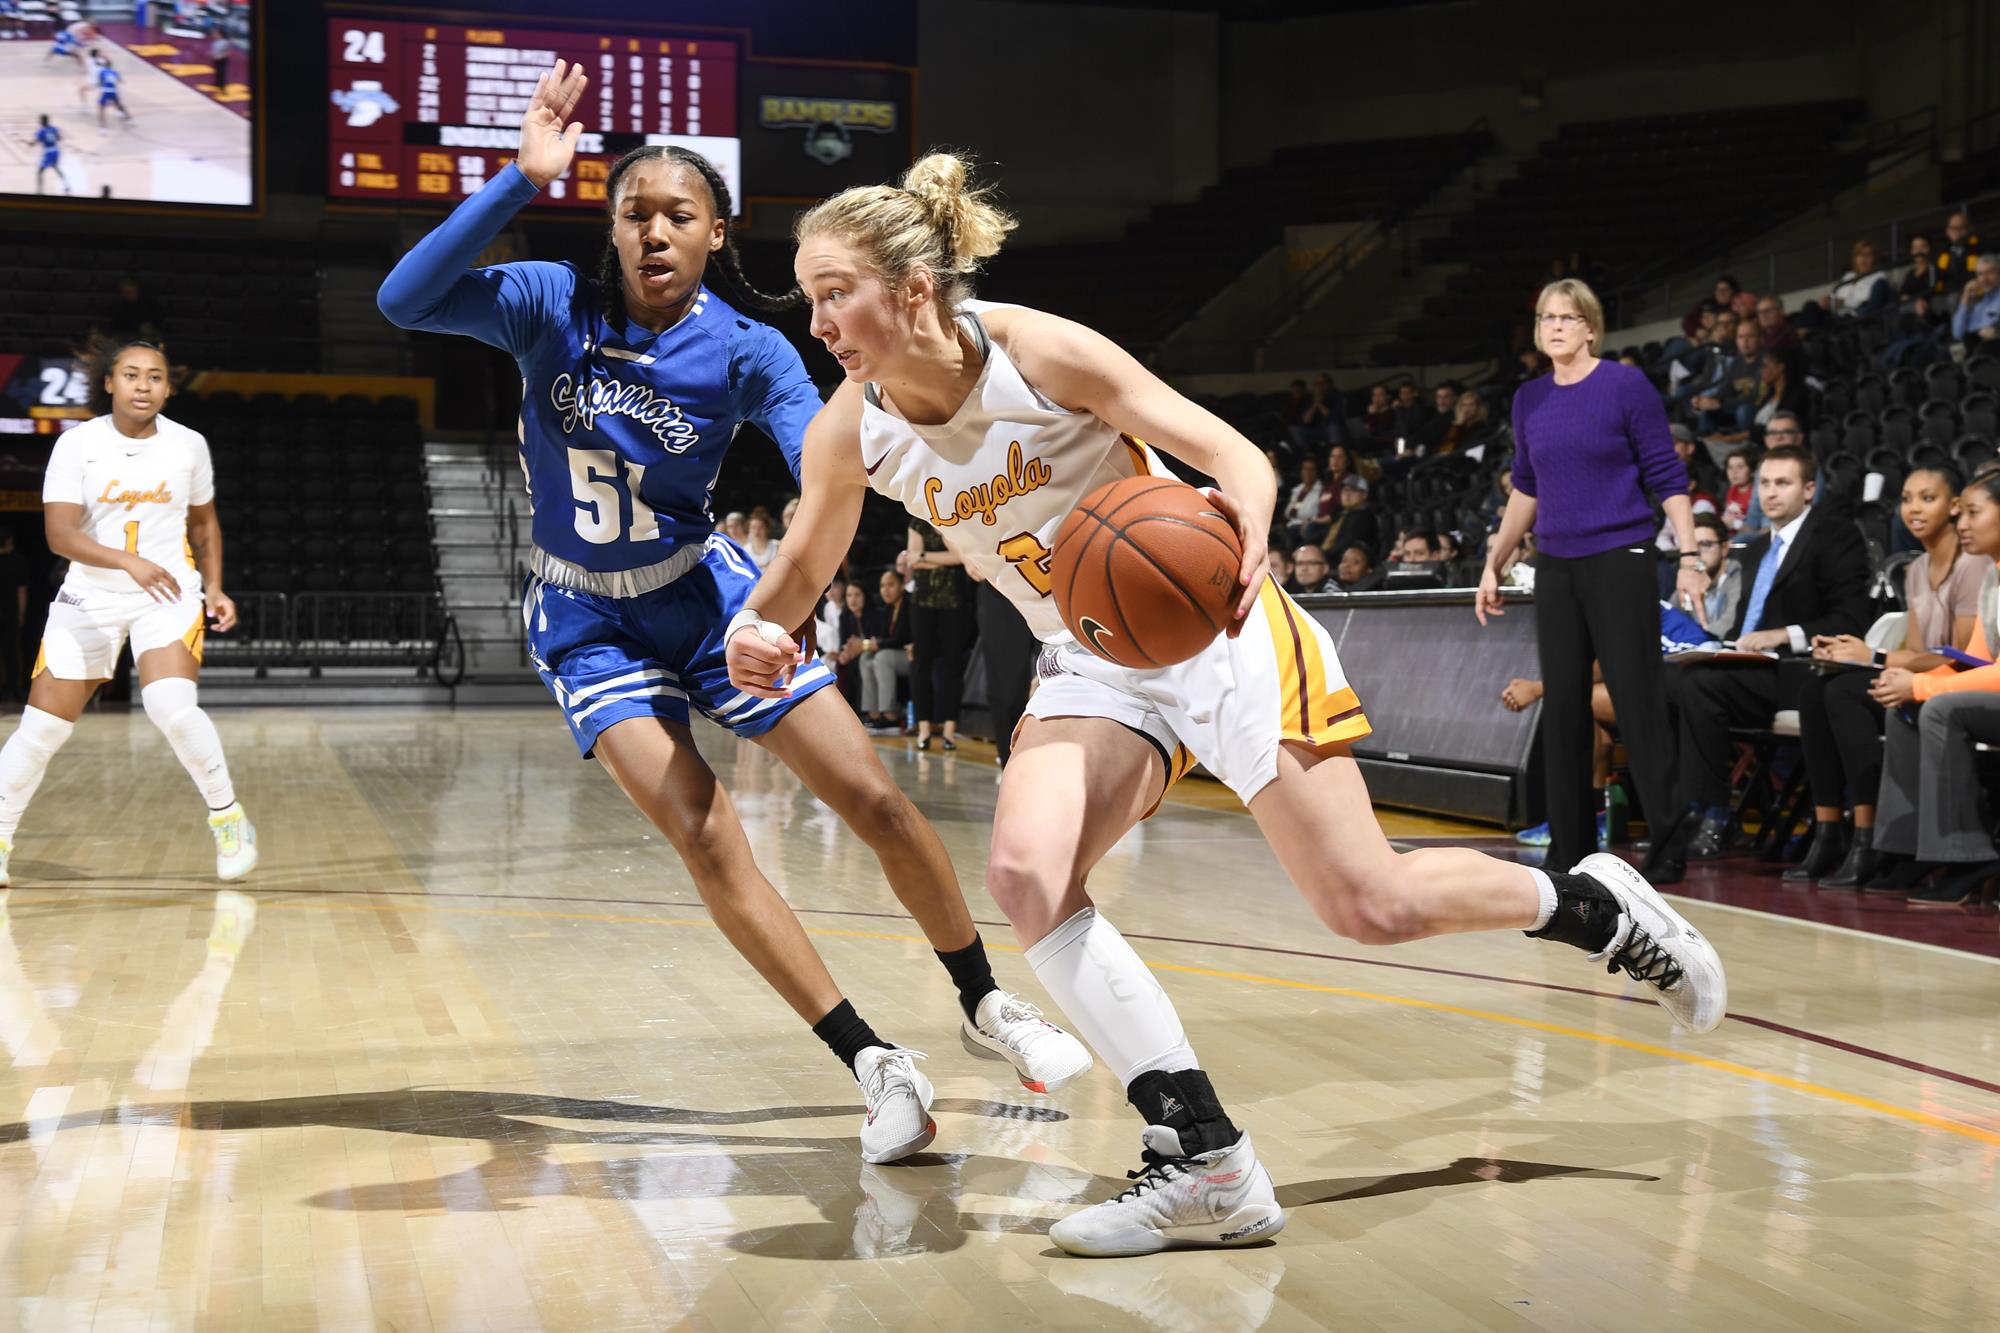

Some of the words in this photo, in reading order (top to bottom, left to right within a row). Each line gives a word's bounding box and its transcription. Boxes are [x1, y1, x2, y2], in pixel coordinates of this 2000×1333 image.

[343, 29, 386, 64] 24
[762, 98, 894, 128] RAMBLERS
[40, 367, 89, 404] 24
[97, 479, 172, 511] Loyola
[567, 447, 660, 544] 51
[924, 440, 1052, 527] Loyola
[123, 520, 141, 557] 1
[996, 531, 1052, 599] 2
